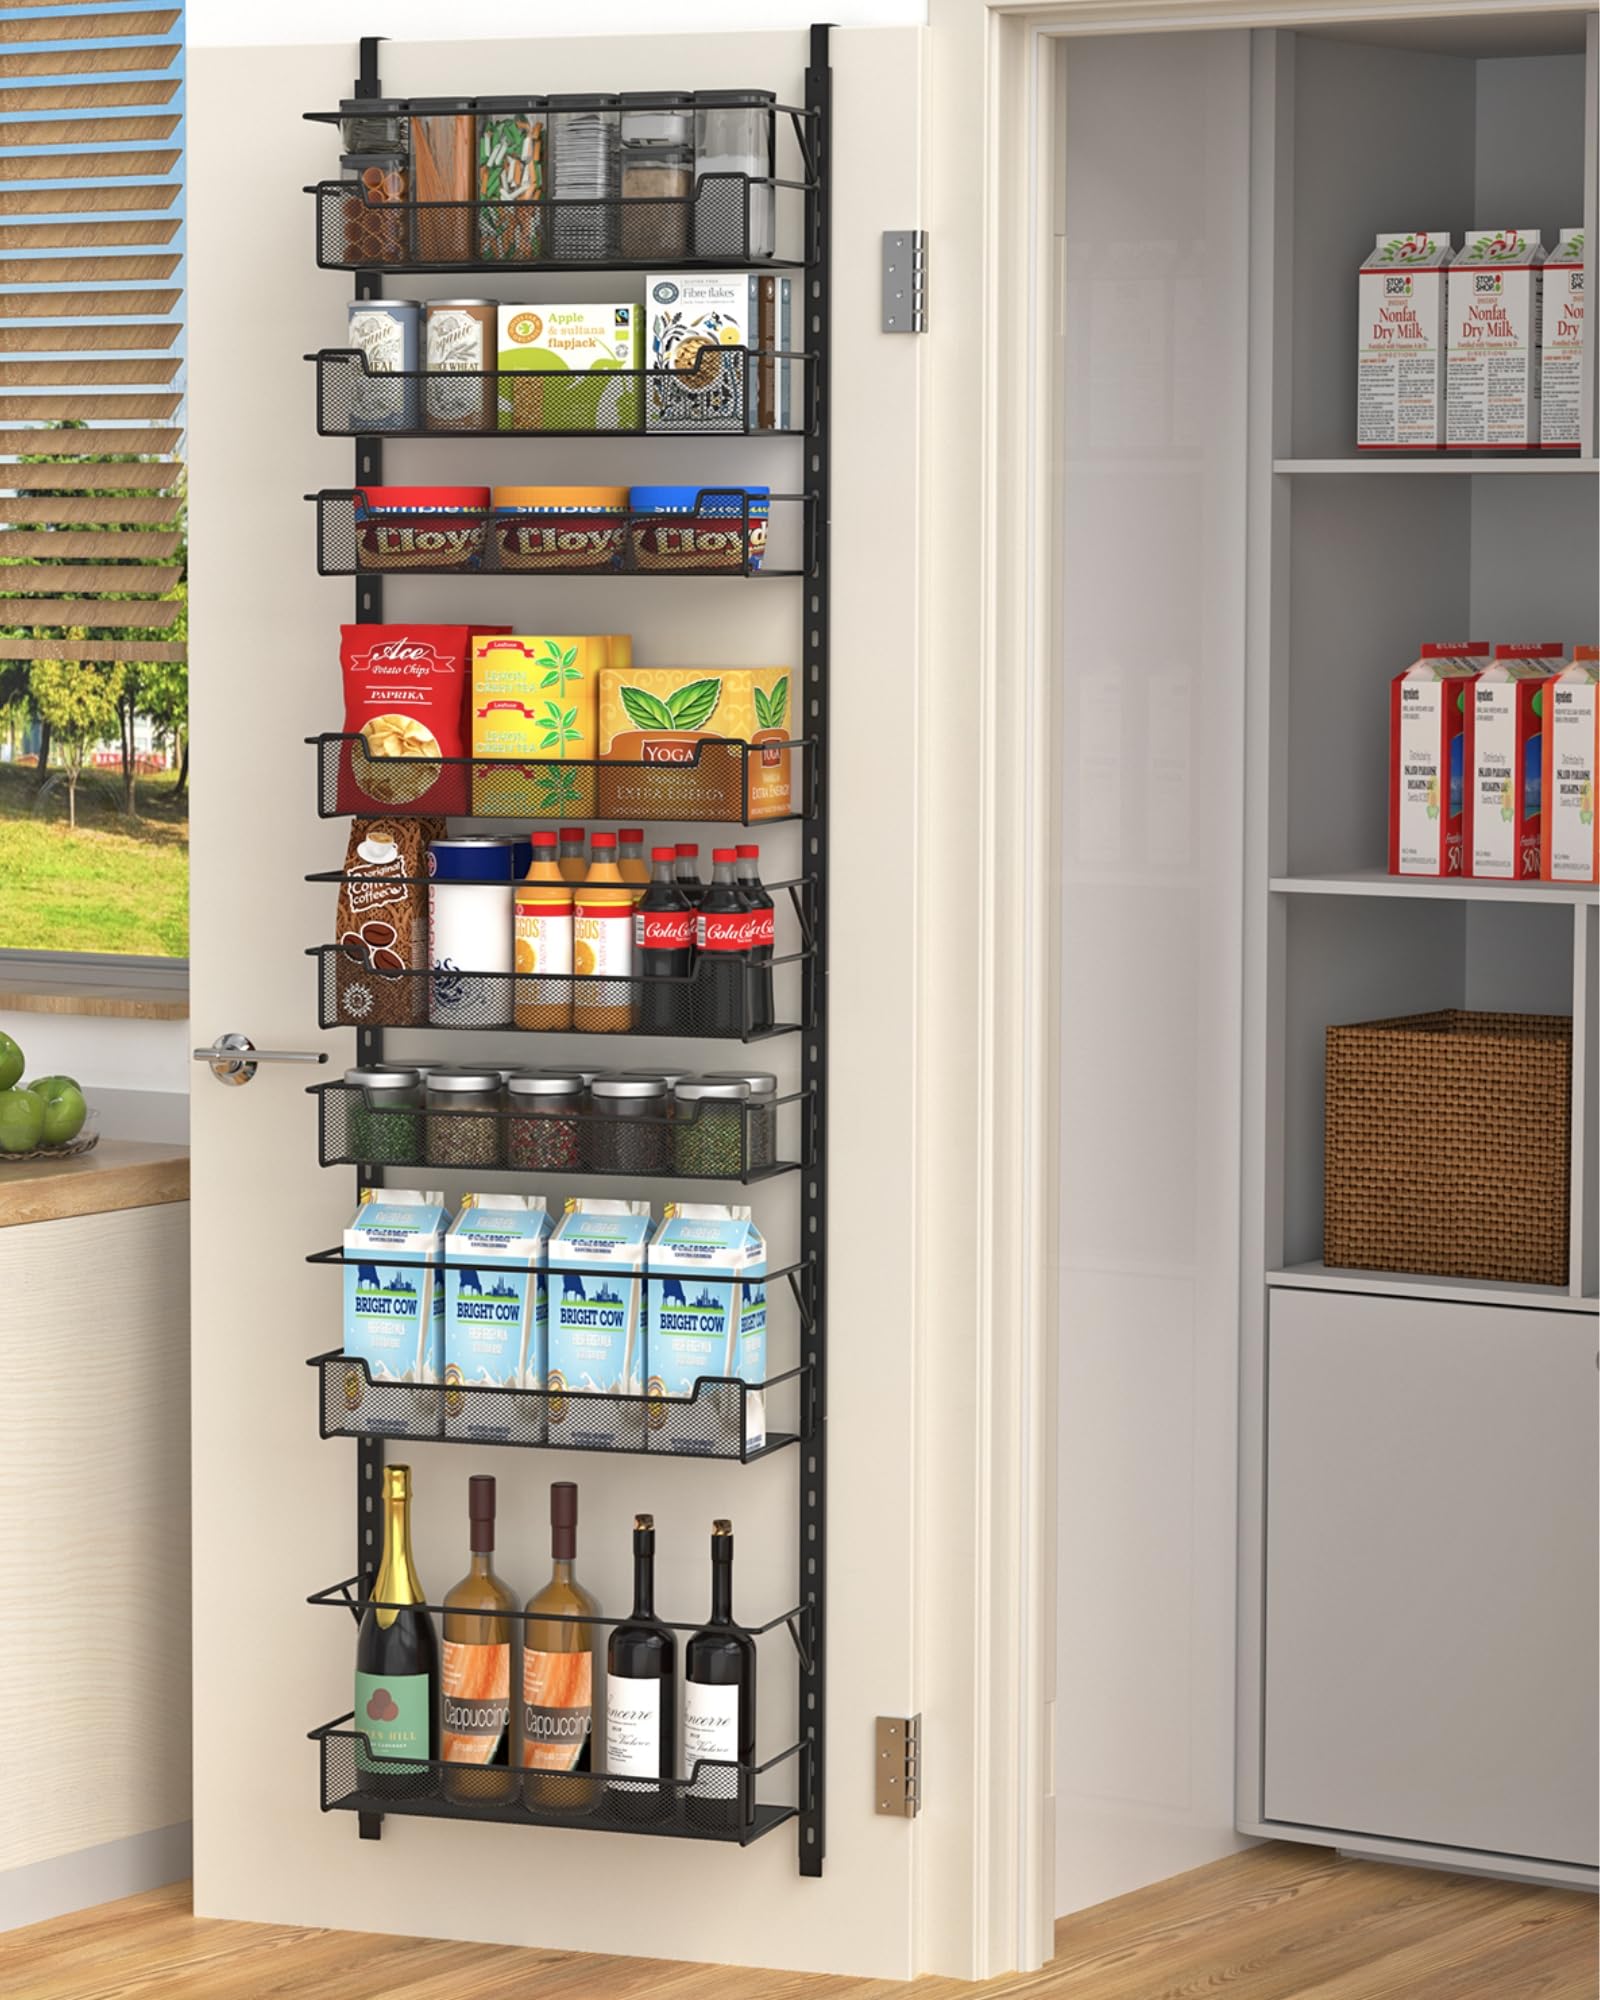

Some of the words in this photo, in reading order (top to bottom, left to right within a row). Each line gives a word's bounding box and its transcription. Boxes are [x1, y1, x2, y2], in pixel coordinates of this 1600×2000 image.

[683, 287, 707, 299] Fibre
[708, 287, 735, 299] flakes
[548, 313, 584, 325] Apple
[1379, 306, 1416, 323] Nonfat
[1468, 304, 1507, 320] Nonfat
[548, 327, 556, 336] &
[560, 326, 605, 336] sultana
[1373, 324, 1395, 344] Dry
[1397, 322, 1424, 339] Milk
[1462, 322, 1484, 342] Dry
[1487, 320, 1514, 337] Milk
[1557, 320, 1580, 340] Dry
[548, 338, 596, 350] flapjack
[373, 636, 430, 661] Ace
[372, 664, 401, 675] Potato
[403, 663, 430, 678] Chips
[371, 691, 425, 700] PAPRIKA
[646, 746, 695, 762] YOGA
[646, 921, 677, 938] Cola
[707, 924, 738, 940] Cola
[355, 1296, 391, 1314] BRIGHT
[393, 1298, 418, 1315] COW
[456, 1302, 494, 1319] BRIGHT
[496, 1304, 520, 1321] COW
[560, 1307, 598, 1326] BRIGHT
[599, 1310, 625, 1328] COW
[659, 1313, 698, 1331] BRIGHT
[699, 1315, 725, 1333] COW
[740, 1314, 756, 1334] BRIGHT
[444, 1698, 511, 1731] Cappuccino
[525, 1706, 593, 1741] Cappuccino
